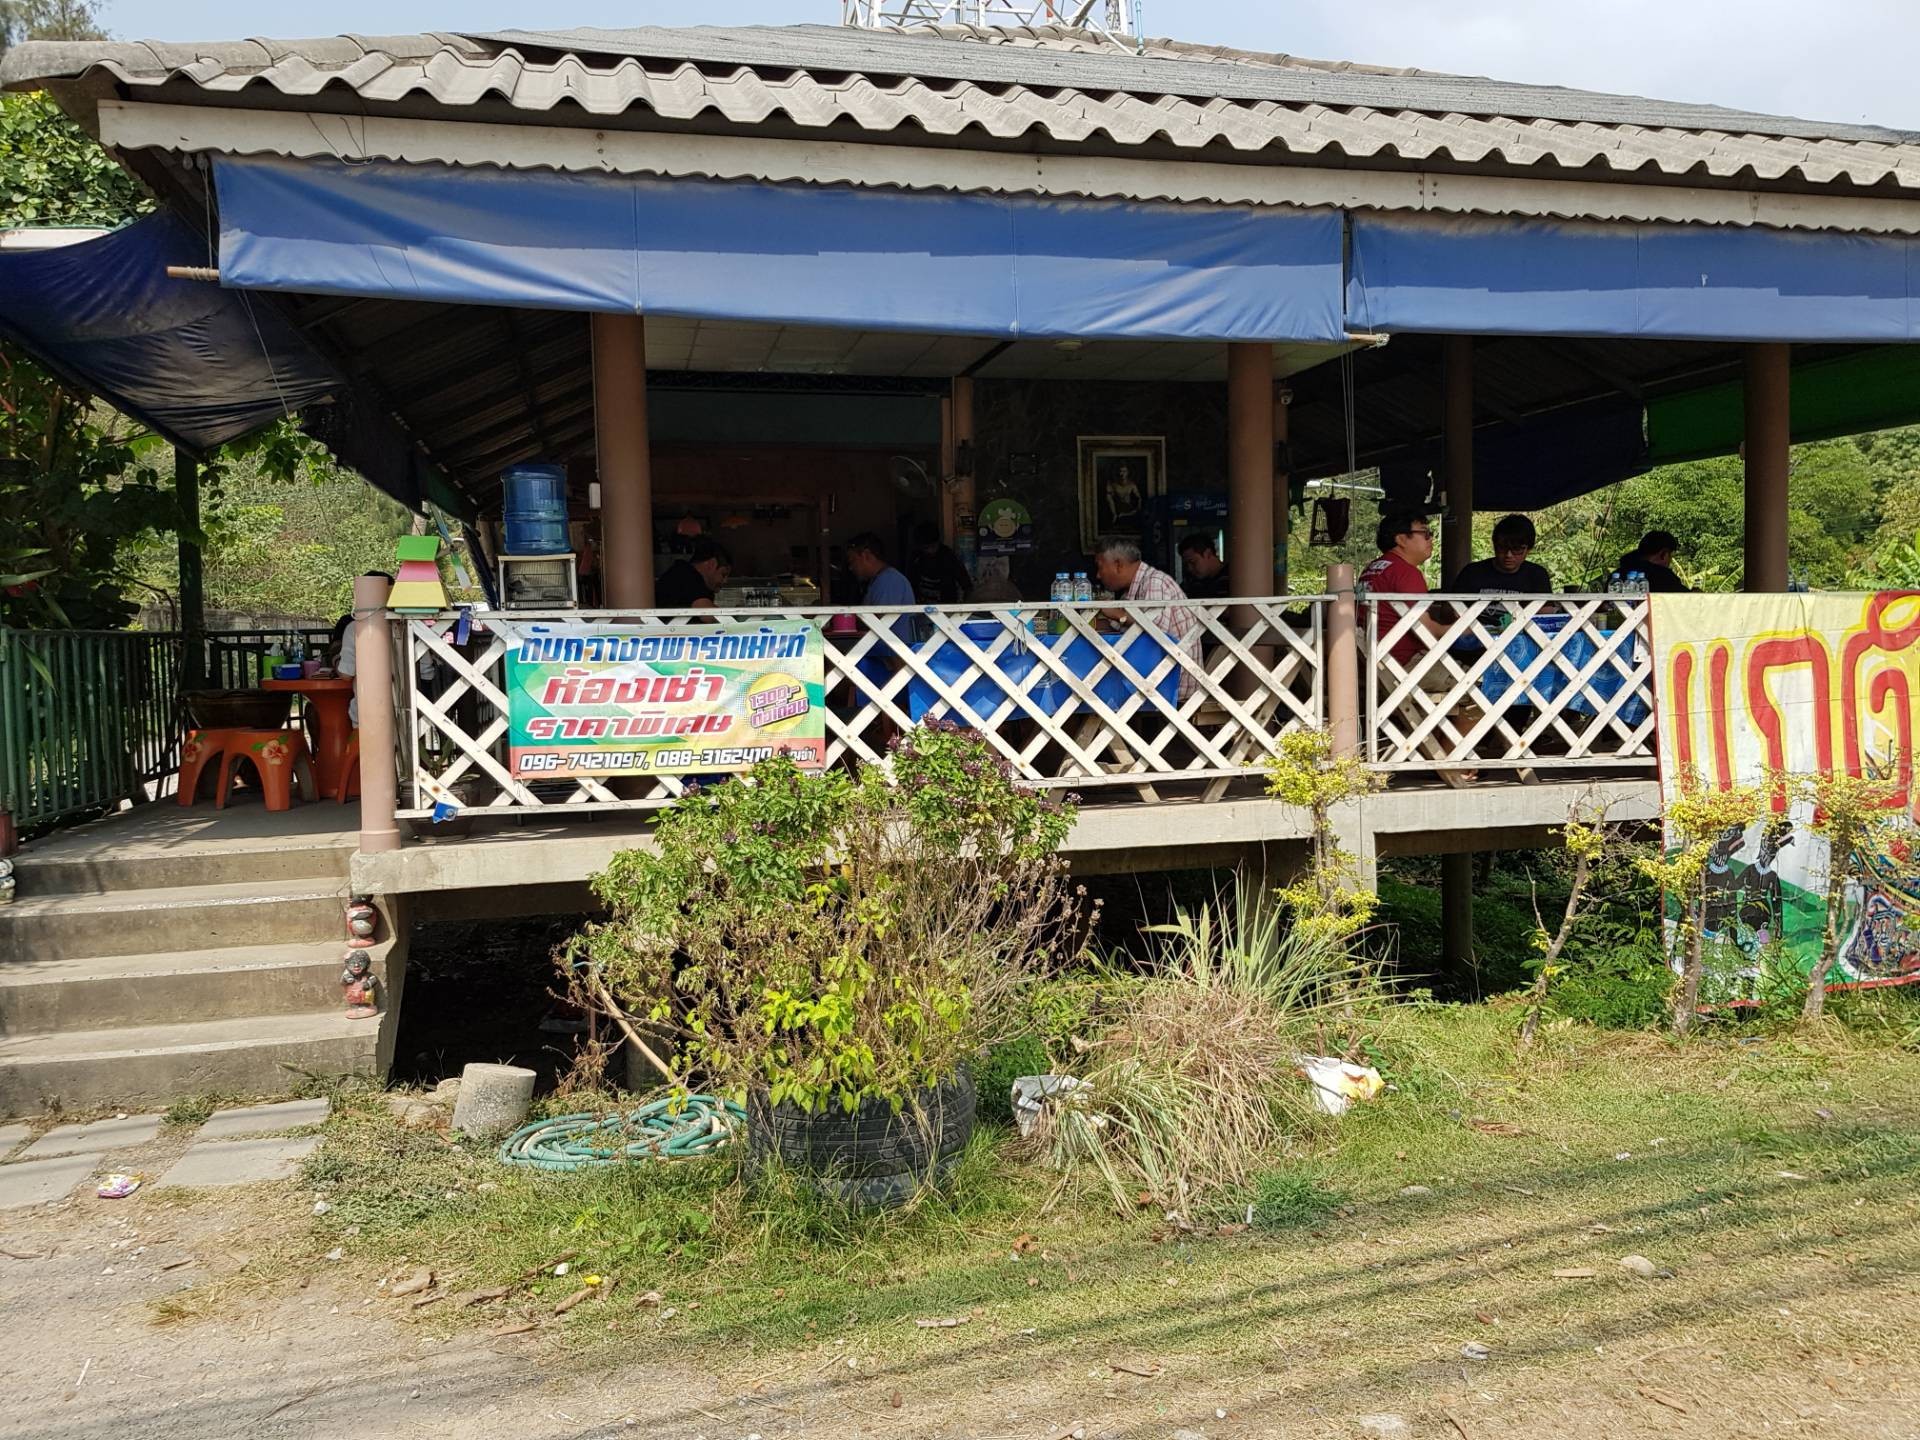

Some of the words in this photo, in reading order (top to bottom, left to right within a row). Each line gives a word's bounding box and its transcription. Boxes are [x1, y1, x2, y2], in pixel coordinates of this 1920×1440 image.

[543, 669, 727, 706] ห้องเช่า
[527, 711, 733, 739] ราคาพิเศษ
[751, 698, 810, 728] ต่อเดือน
[520, 752, 650, 771] 096-7421097,
